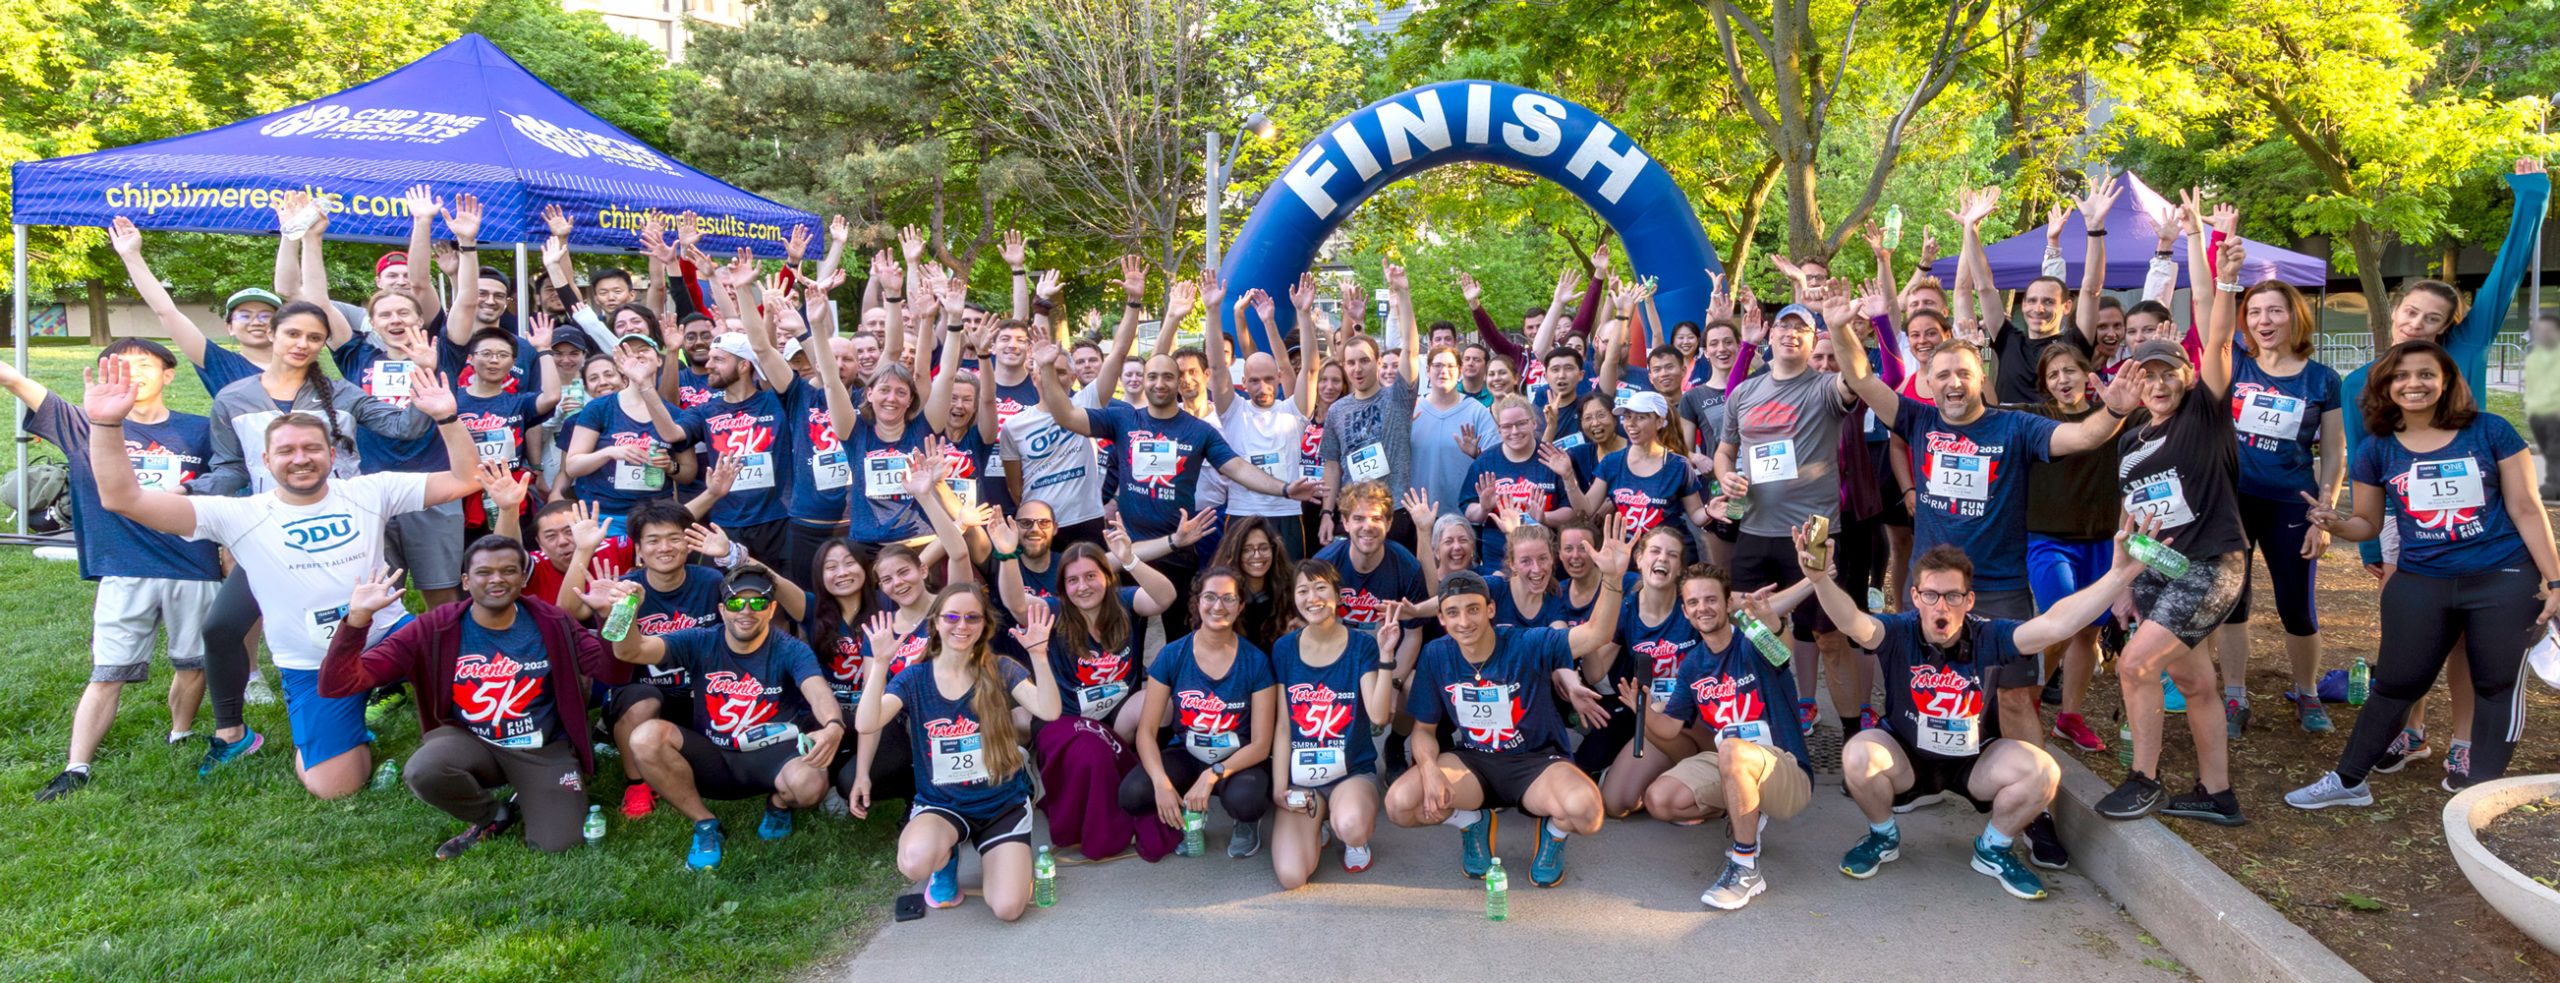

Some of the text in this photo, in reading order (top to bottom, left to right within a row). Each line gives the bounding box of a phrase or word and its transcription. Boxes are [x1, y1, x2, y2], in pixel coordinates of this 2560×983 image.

[353, 108, 486, 129] CHIP TIME
[327, 120, 469, 138] RESULTS
[351, 133, 403, 142] ABOUT
[1283, 84, 1649, 220] FINISH
[105, 182, 410, 217] chiptimereslts.com
[599, 204, 782, 242] chiptmesults.com
[385, 374, 406, 386] 14
[1701, 396, 1719, 409] JOY
[705, 413, 757, 433] Toronto
[2257, 411, 2281, 426] 44
[477, 443, 504, 456] 107
[727, 427, 766, 457] 5K
[1926, 431, 2004, 456] Toronto 2023
[1149, 454, 1158, 466] 2
[1356, 459, 1379, 475] 152
[1763, 457, 1780, 472] 72
[2442, 462, 2464, 471] ONE
[737, 467, 763, 481] 174
[829, 464, 848, 478] 75
[876, 472, 903, 485] 110
[1942, 471, 1974, 487] 121
[2129, 468, 2178, 490] BLACKS
[1158, 487, 1175, 495] FUN
[2430, 480, 2458, 497] 15
[1613, 488, 1651, 506] Toronto
[1961, 501, 1984, 509] FUN
[1961, 508, 1984, 516] RUN
[2138, 500, 2175, 517] 122
[1625, 507, 1659, 531] 5K
[2459, 520, 2481, 531] FUN
[2461, 526, 2484, 539] RUN
[296, 561, 330, 570] PERFET
[332, 552, 366, 566] ALLIANCE
[637, 613, 698, 636] Toronto
[1679, 640, 1696, 649] 2023
[454, 654, 549, 682] Toronto 2023
[705, 671, 764, 696] Toronto
[1910, 664, 1970, 690] Toronto
[1288, 683, 1338, 703] Toronto
[1480, 689, 1497, 697] ONE
[1508, 682, 1521, 694] 23
[462, 678, 537, 726] 5K
[1178, 690, 1227, 711] Toronto
[711, 697, 772, 738] 5K
[1472, 704, 1493, 718] 29
[507, 716, 532, 729] FUN
[507, 724, 534, 736] RUN
[923, 717, 980, 739] Toronto
[1299, 704, 1346, 741] 5K
[706, 728, 729, 747] ISRM
[963, 736, 981, 746] ONE
[1291, 741, 1318, 749] SMRM
[1931, 731, 1967, 746] 173
[950, 754, 974, 770] 28
[1208, 749, 1218, 759] 5
[1308, 767, 1329, 780] 22
